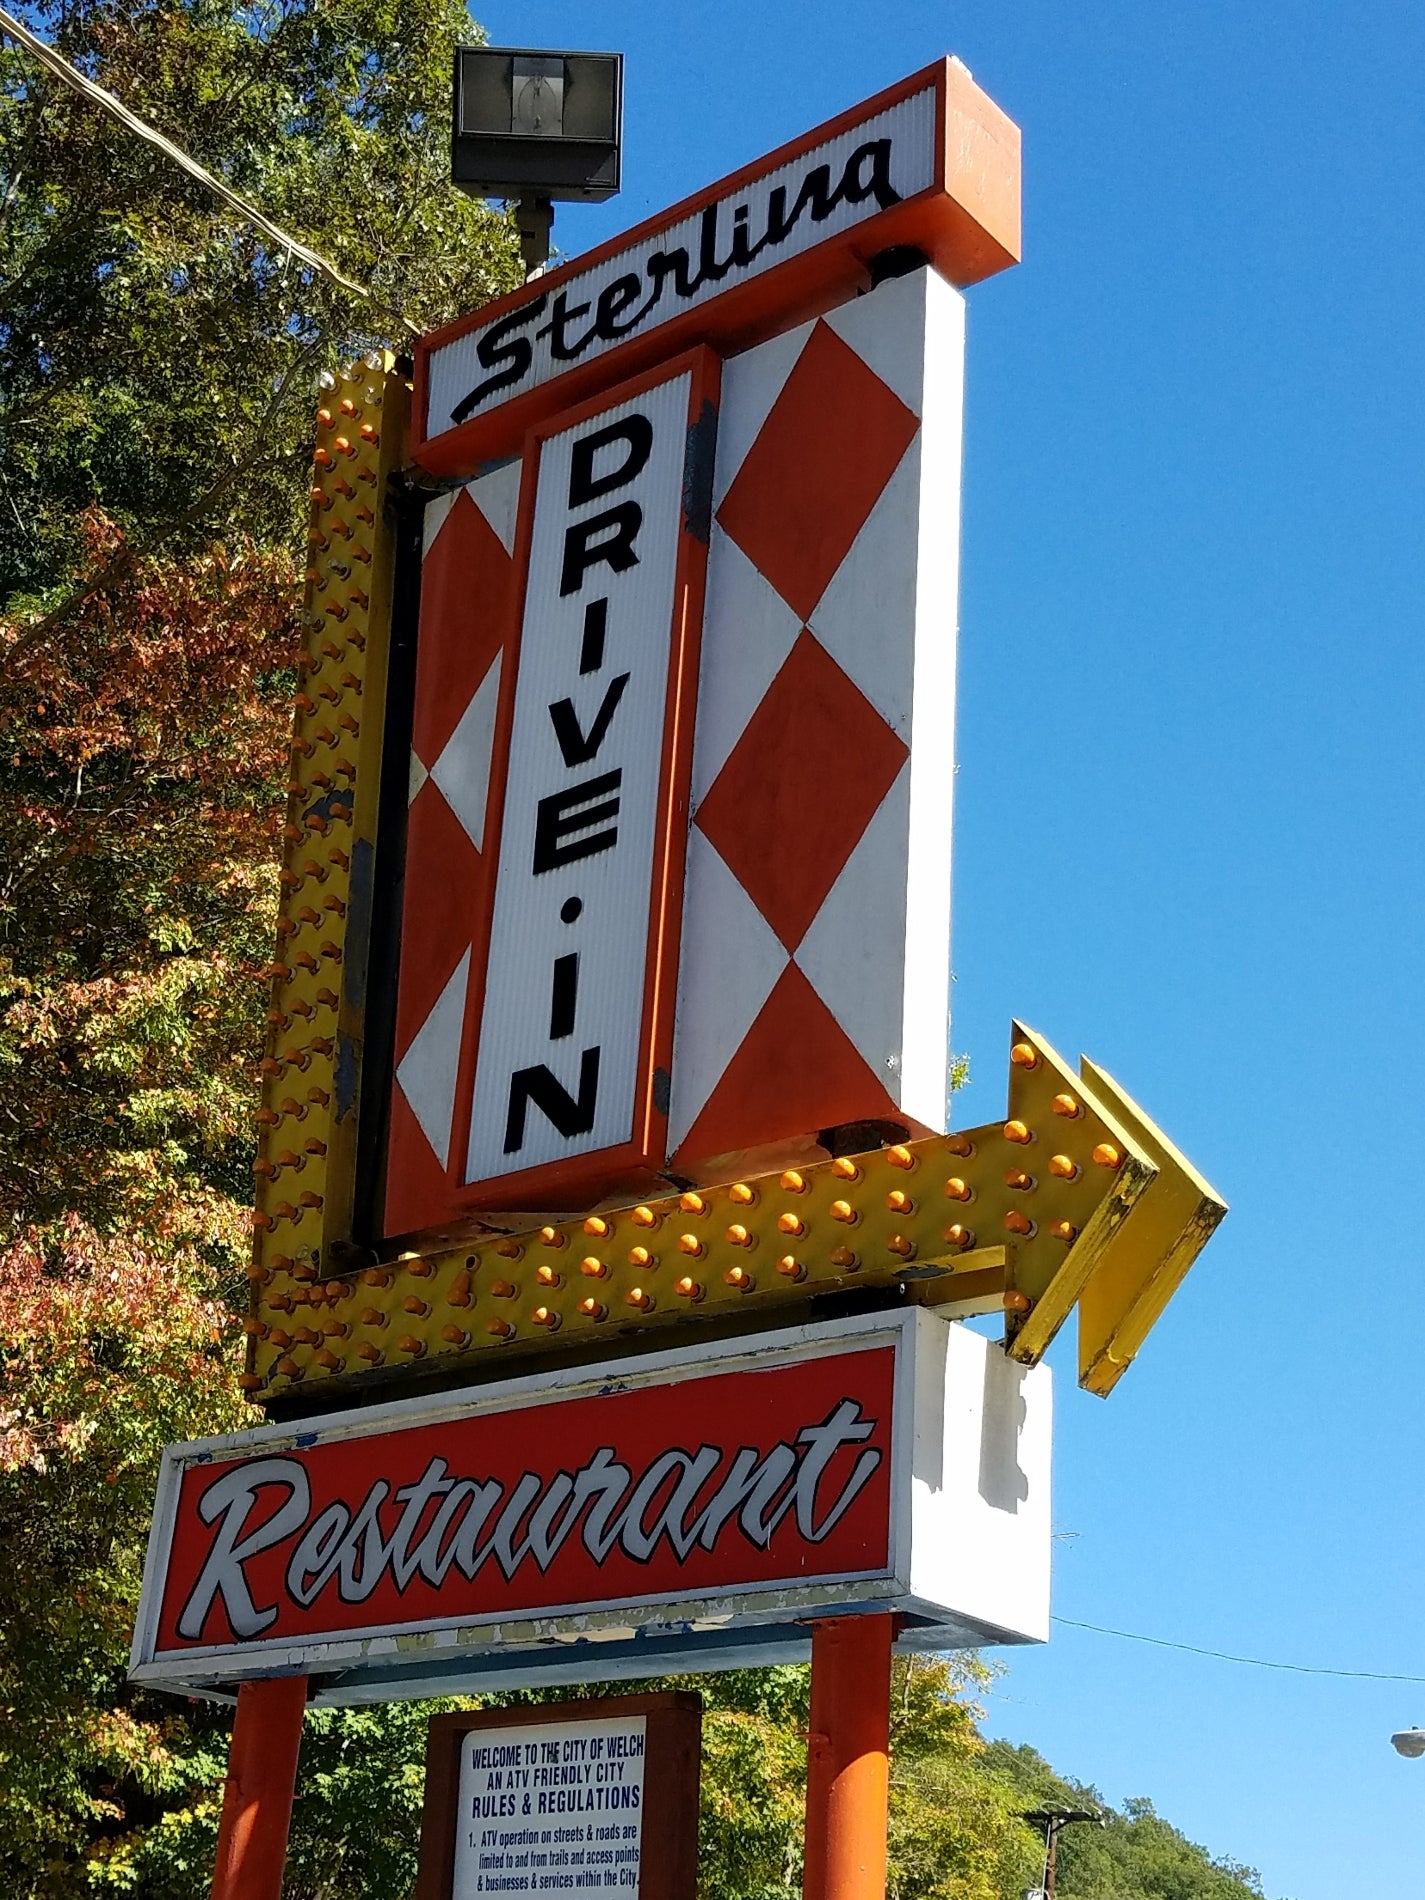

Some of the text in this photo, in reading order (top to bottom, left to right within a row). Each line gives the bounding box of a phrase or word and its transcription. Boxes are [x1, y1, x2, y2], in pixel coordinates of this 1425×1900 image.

[175, 1397, 882, 1641] Restaurant
[472, 1734, 644, 1770] WELCOME TO THE CITY OF WELCH
[487, 1761, 625, 1790] AN ATV FRIENDLY CITY
[472, 1785, 640, 1819] RULES & REGULATIONS
[469, 1823, 637, 1850] 1. ATV operation on streets & roads are
[479, 1845, 640, 1870] limited to and from trails and access points
[477, 1874, 484, 1892] &
[485, 1874, 529, 1892] businesses
[531, 1872, 538, 1889] &
[539, 1871, 574, 1889] services
[575, 1869, 602, 1888] within
[603, 1868, 618, 1887] the
